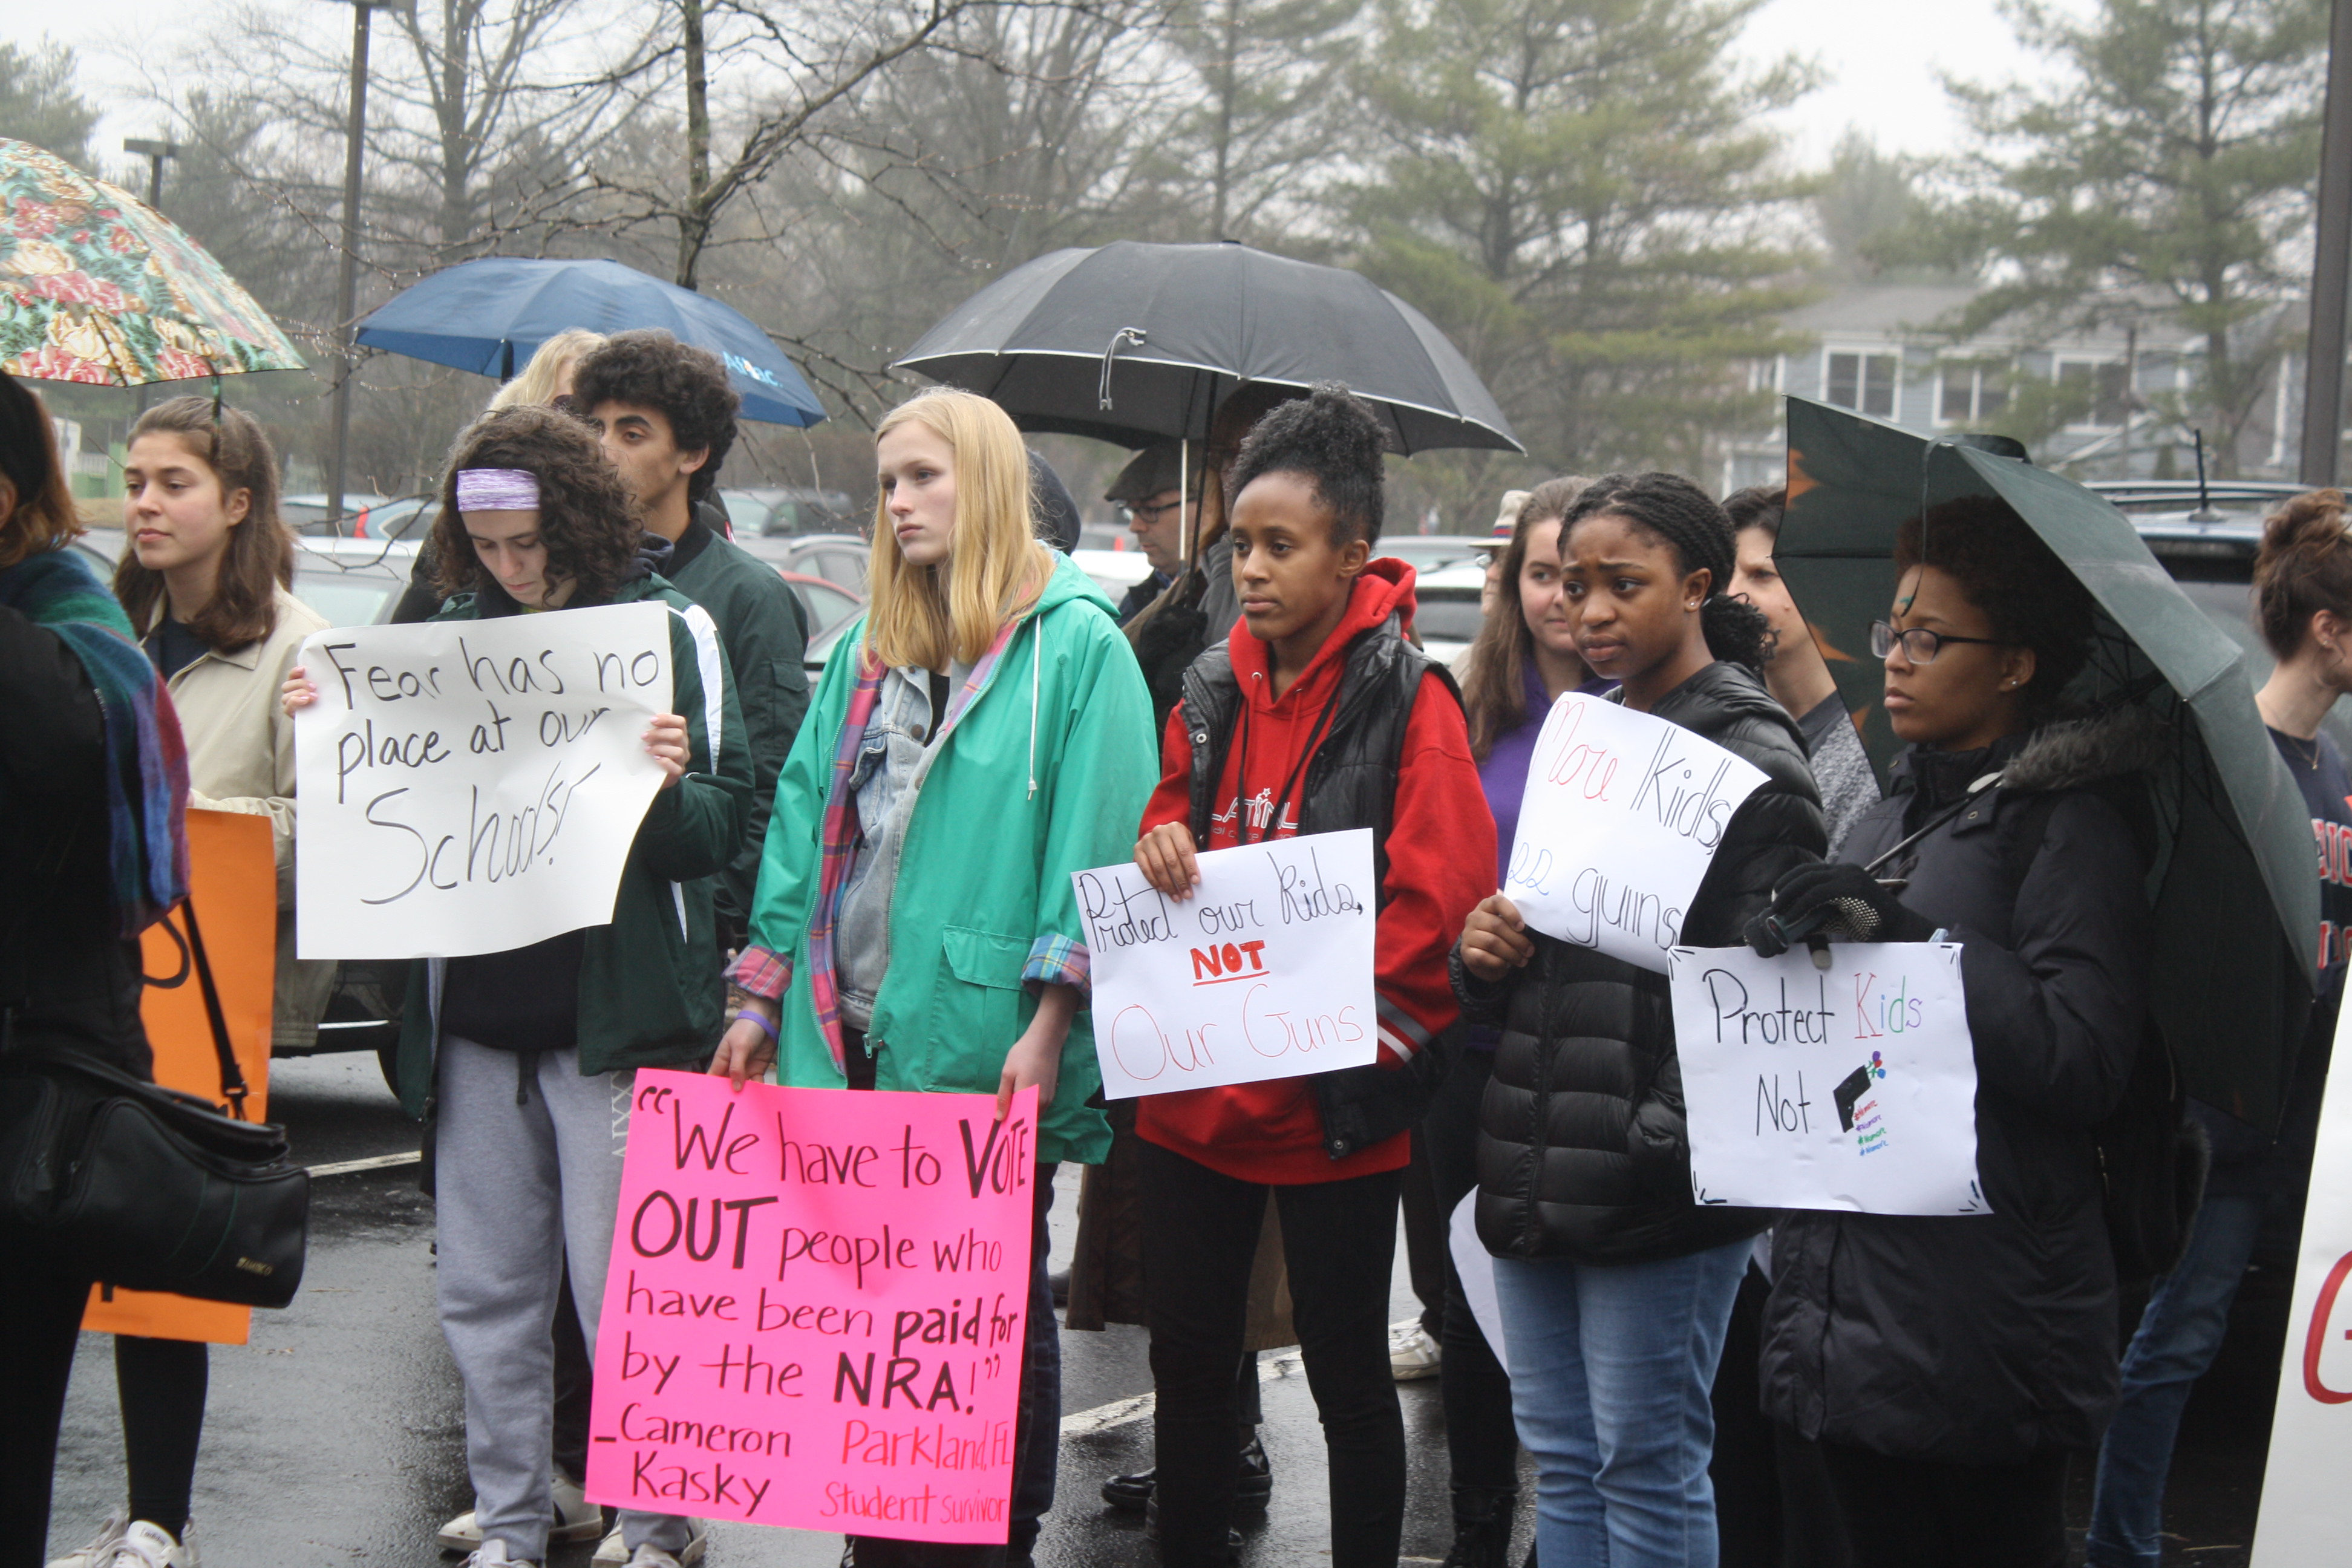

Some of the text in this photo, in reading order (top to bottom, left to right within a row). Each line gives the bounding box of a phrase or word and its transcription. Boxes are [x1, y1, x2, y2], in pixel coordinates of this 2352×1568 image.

[324, 636, 659, 710] Fear has no
[338, 701, 611, 804] place at our
[1532, 698, 1618, 802] More
[361, 760, 601, 906] Schools!
[1198, 899, 1264, 935] our
[1267, 846, 1365, 924] Kids,
[1566, 867, 1682, 950] guns
[1190, 940, 1266, 980] NOT
[1111, 984, 1364, 1080] Our Guns
[1702, 969, 1922, 1044] Protect Kids
[1757, 1070, 1811, 1136] Not
[777, 1111, 879, 1187] have
[890, 1125, 941, 1188] to
[959, 1117, 1028, 1199] VOTE
[631, 1189, 1002, 1290] OUT people who
[626, 1270, 1018, 1358] have been paid for
[621, 1331, 681, 1396] by
[699, 1344, 803, 1398] the
[632, 1451, 771, 1517] Kasky
[819, 1481, 937, 1524] Student
